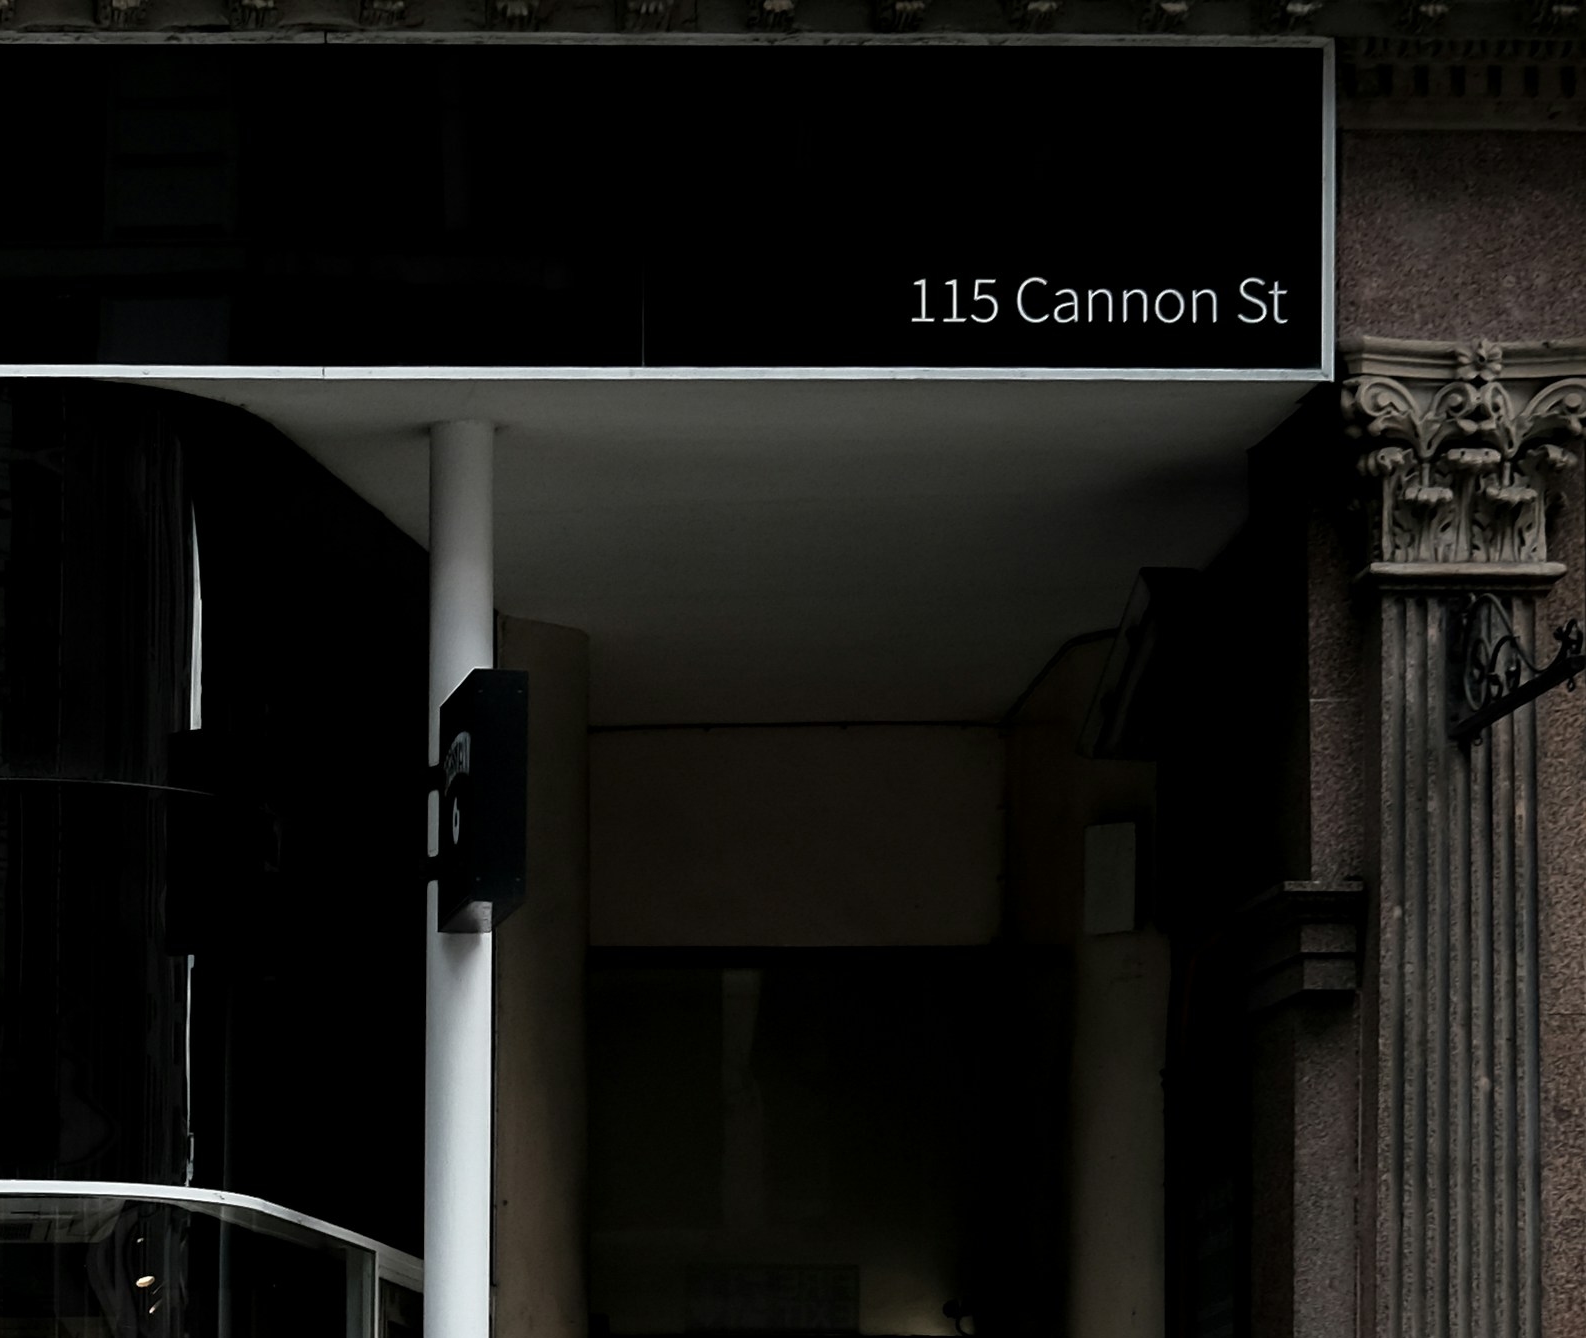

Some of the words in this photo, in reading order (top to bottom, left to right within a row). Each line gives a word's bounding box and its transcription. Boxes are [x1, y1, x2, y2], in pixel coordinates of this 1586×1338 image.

[911, 278, 999, 324] 115
[1016, 276, 1218, 325] Cannon
[1237, 277, 1289, 325] St
